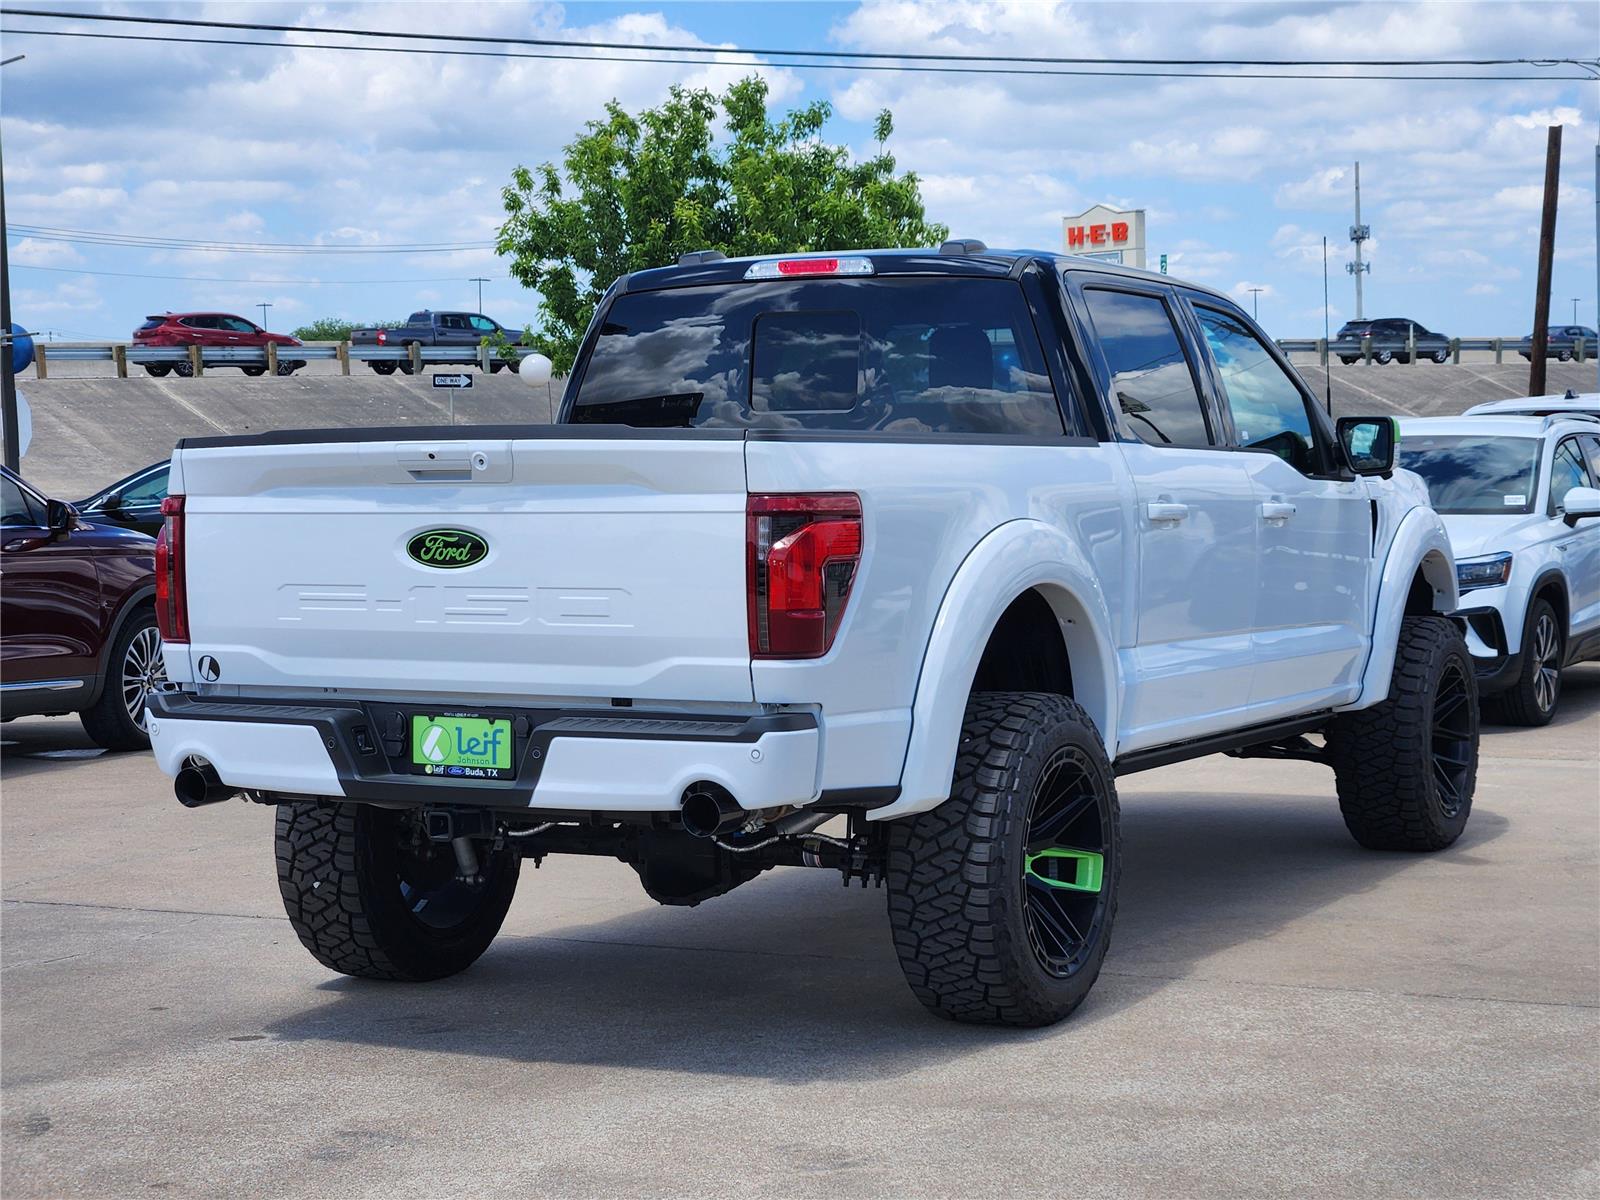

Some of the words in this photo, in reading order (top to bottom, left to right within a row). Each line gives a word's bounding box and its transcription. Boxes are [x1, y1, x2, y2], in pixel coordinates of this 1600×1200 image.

[421, 534, 472, 561] Ford
[456, 726, 504, 765] leif
[457, 756, 490, 765] Johnson
[465, 767, 486, 777] Buda,
[486, 768, 498, 777] TX
